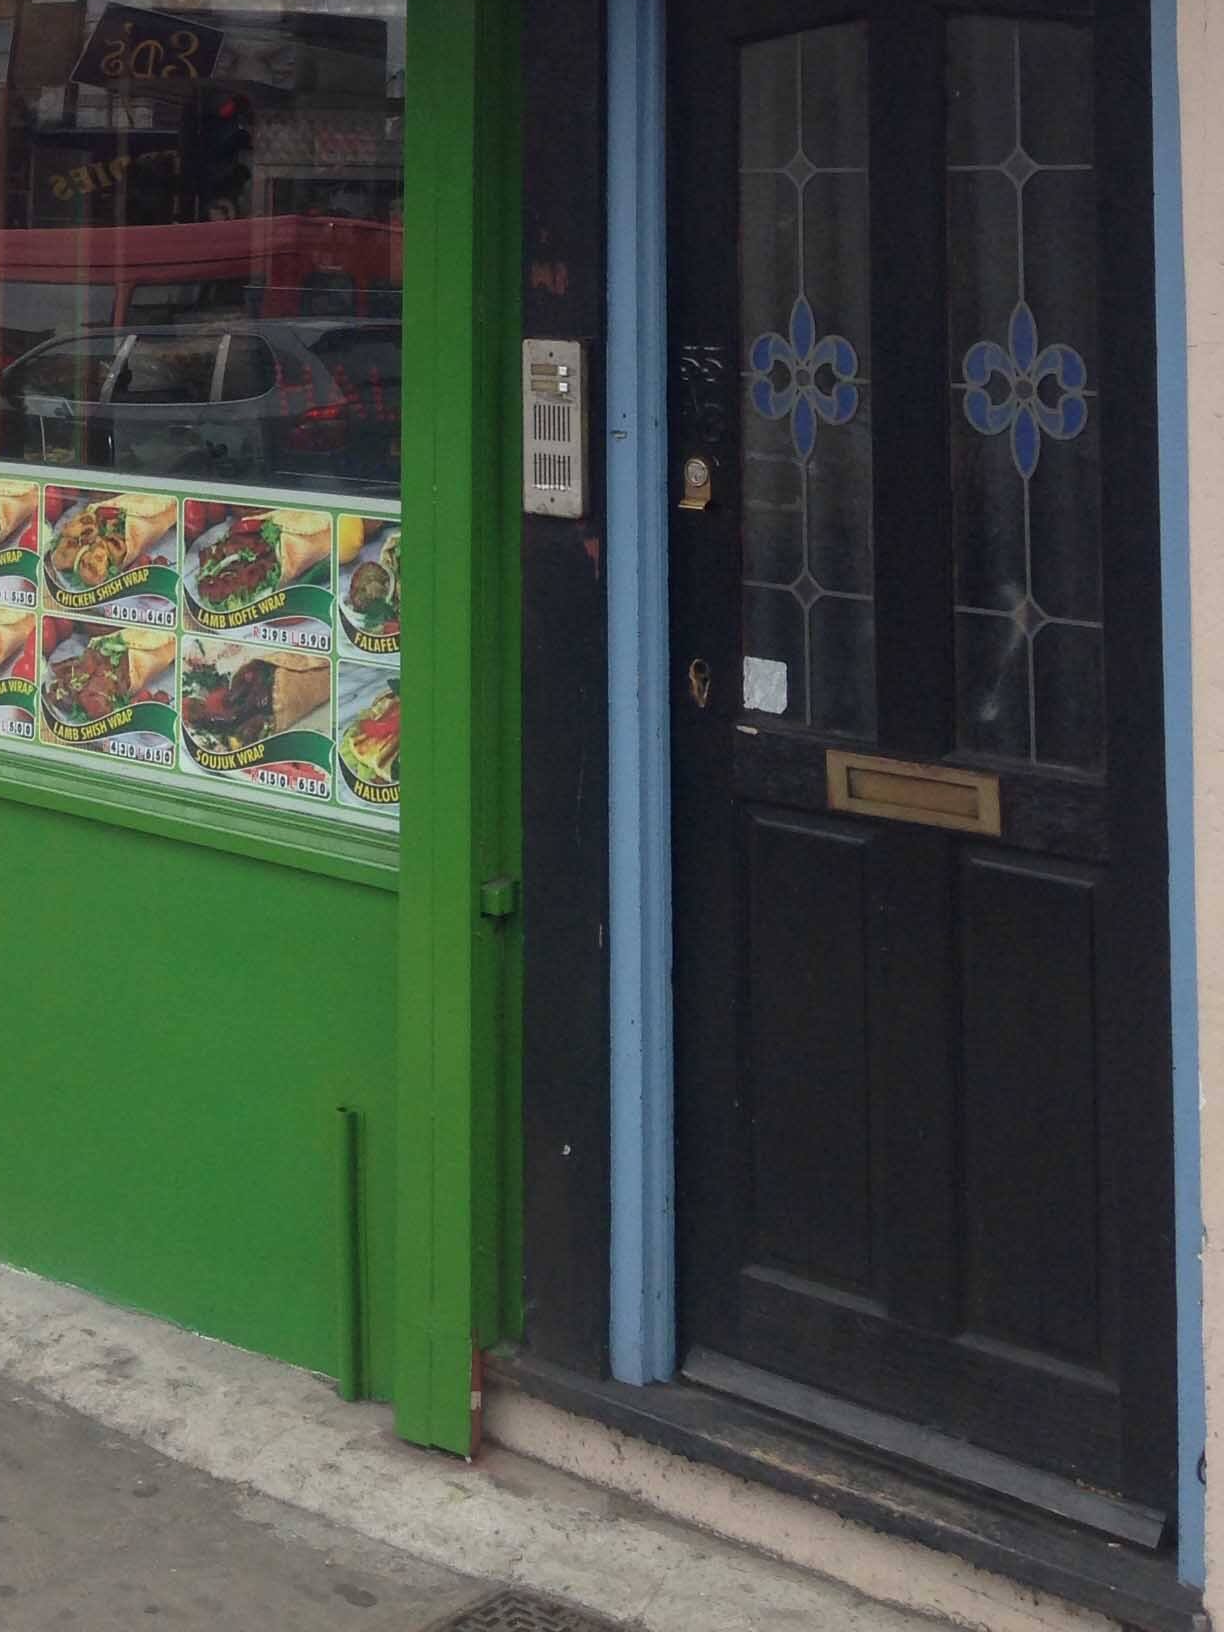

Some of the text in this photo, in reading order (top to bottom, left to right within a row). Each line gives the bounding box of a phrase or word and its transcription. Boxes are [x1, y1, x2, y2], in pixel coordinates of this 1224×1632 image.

[56, 569, 149, 607] CHICKEN SHISH WRAP
[198, 592, 287, 628] LAMB KOFTE WRAP
[354, 632, 400, 653] FALAFEL
[7, 680, 33, 696] WRAP
[53, 709, 134, 741] LAMB SHISH WRAP
[195, 743, 265, 769] SOUJUK WRAP
[354, 780, 400, 802] HALLOU
